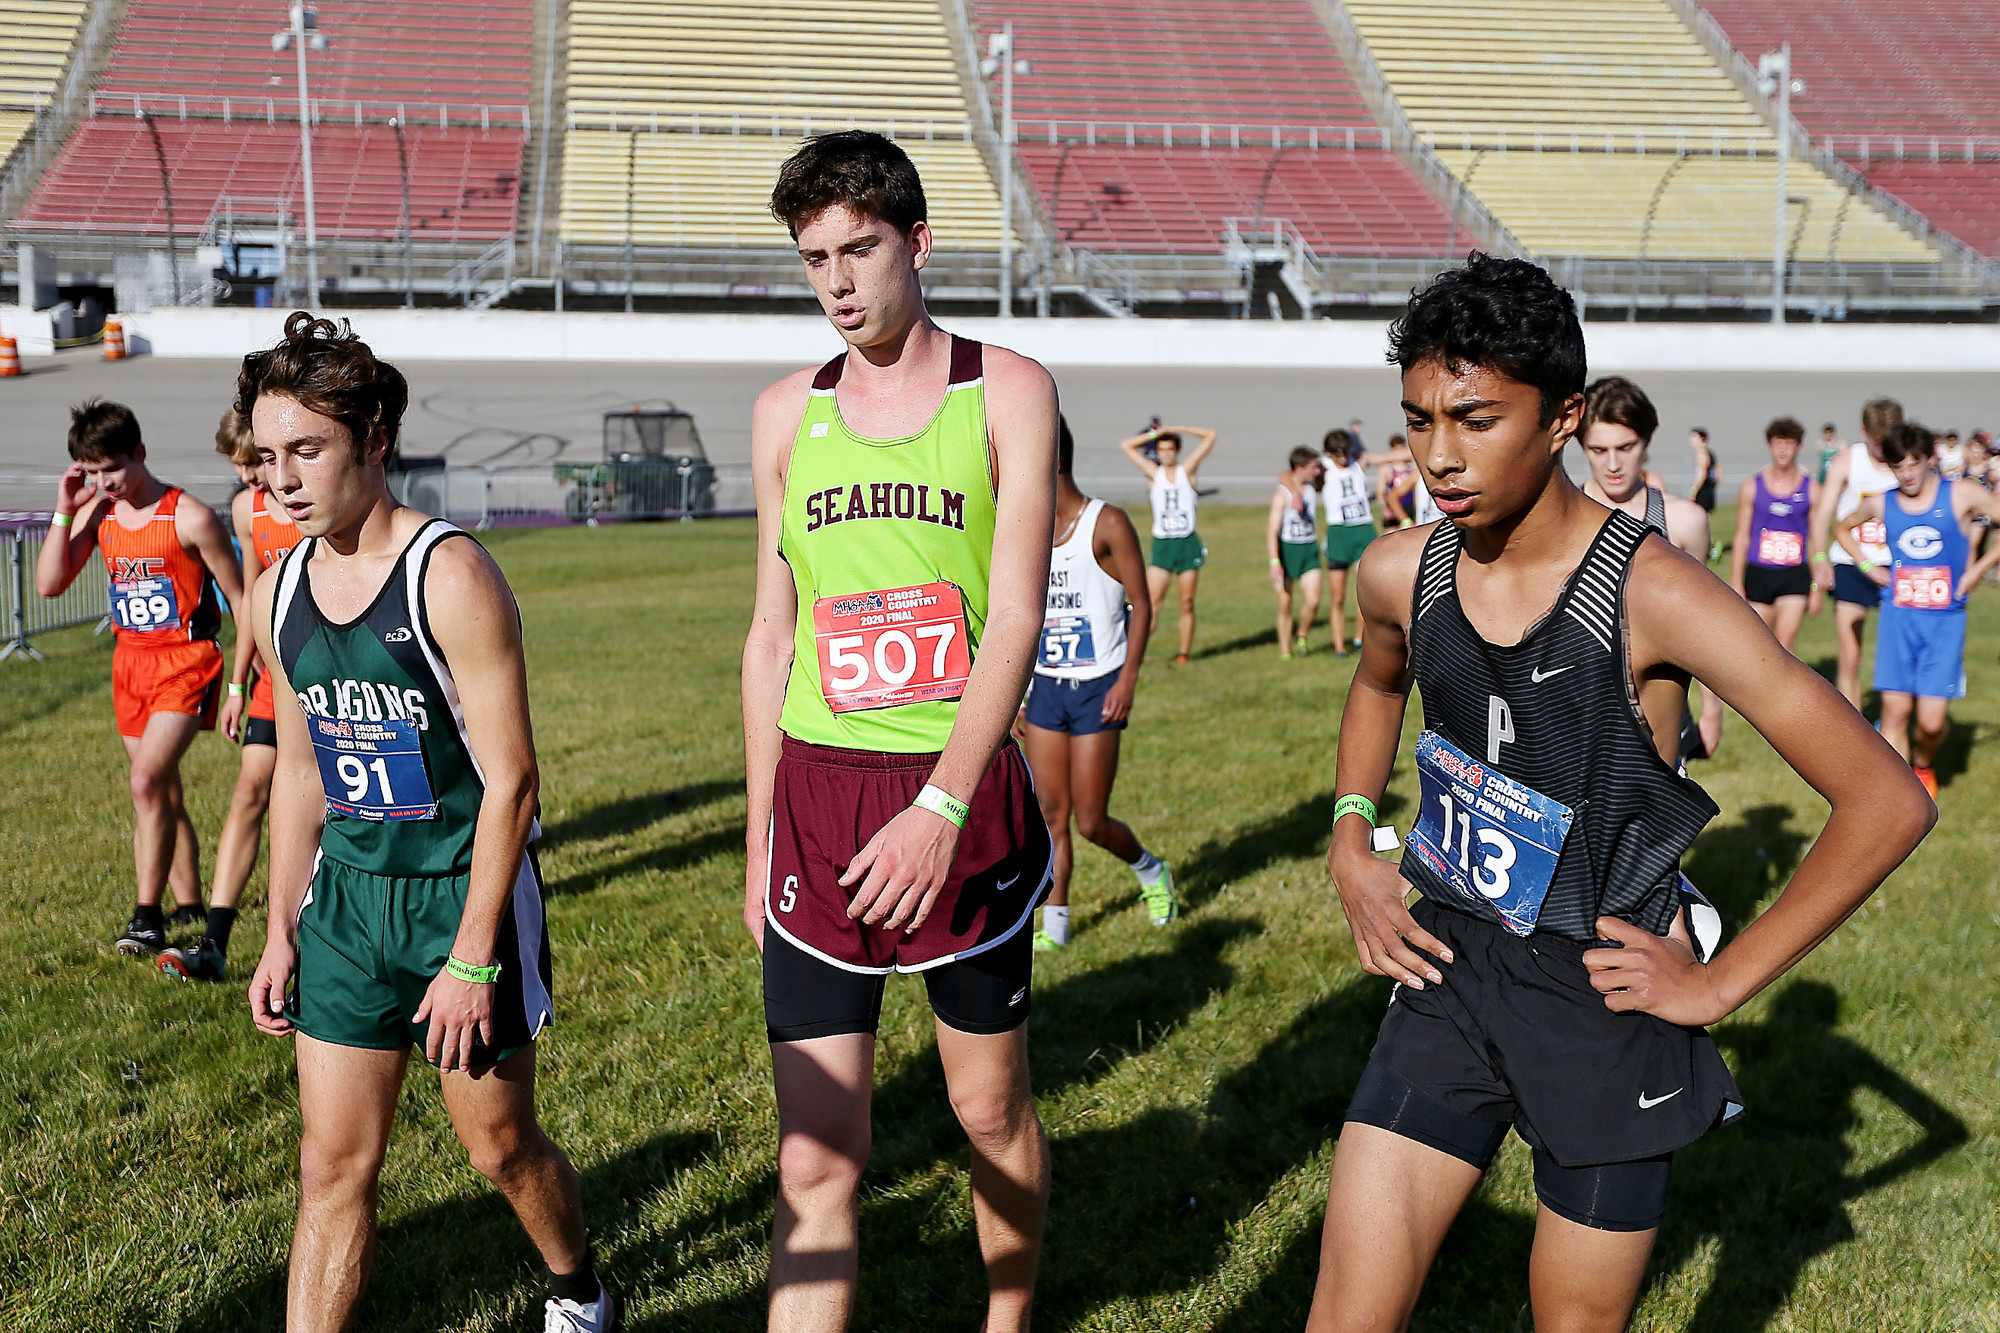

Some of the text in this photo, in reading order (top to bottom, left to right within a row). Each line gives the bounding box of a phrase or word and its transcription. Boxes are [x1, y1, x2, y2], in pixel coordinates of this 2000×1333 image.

[806, 483, 966, 533] SEAHOLM
[1165, 489, 1179, 510] H
[886, 589, 923, 601] CROSS
[887, 596, 938, 610] COUNTRY
[1896, 579, 1949, 603] 520
[116, 595, 170, 626] 189
[860, 614, 884, 626] 2020
[886, 611, 915, 623] FINAL
[828, 622, 957, 691] 507
[1045, 633, 1081, 663] 57
[354, 724, 384, 732] CROSS
[355, 732, 397, 740] COUNTRY
[1488, 695, 1515, 764] P
[335, 739, 378, 751] 2020 FINAL
[336, 754, 395, 804] 91
[1486, 776, 1531, 804] CROSS
[1451, 781, 1507, 823] 2020 FINAL
[1483, 786, 1543, 823] COUNTRY
[1439, 793, 1517, 900] 113
[779, 874, 799, 914] S
